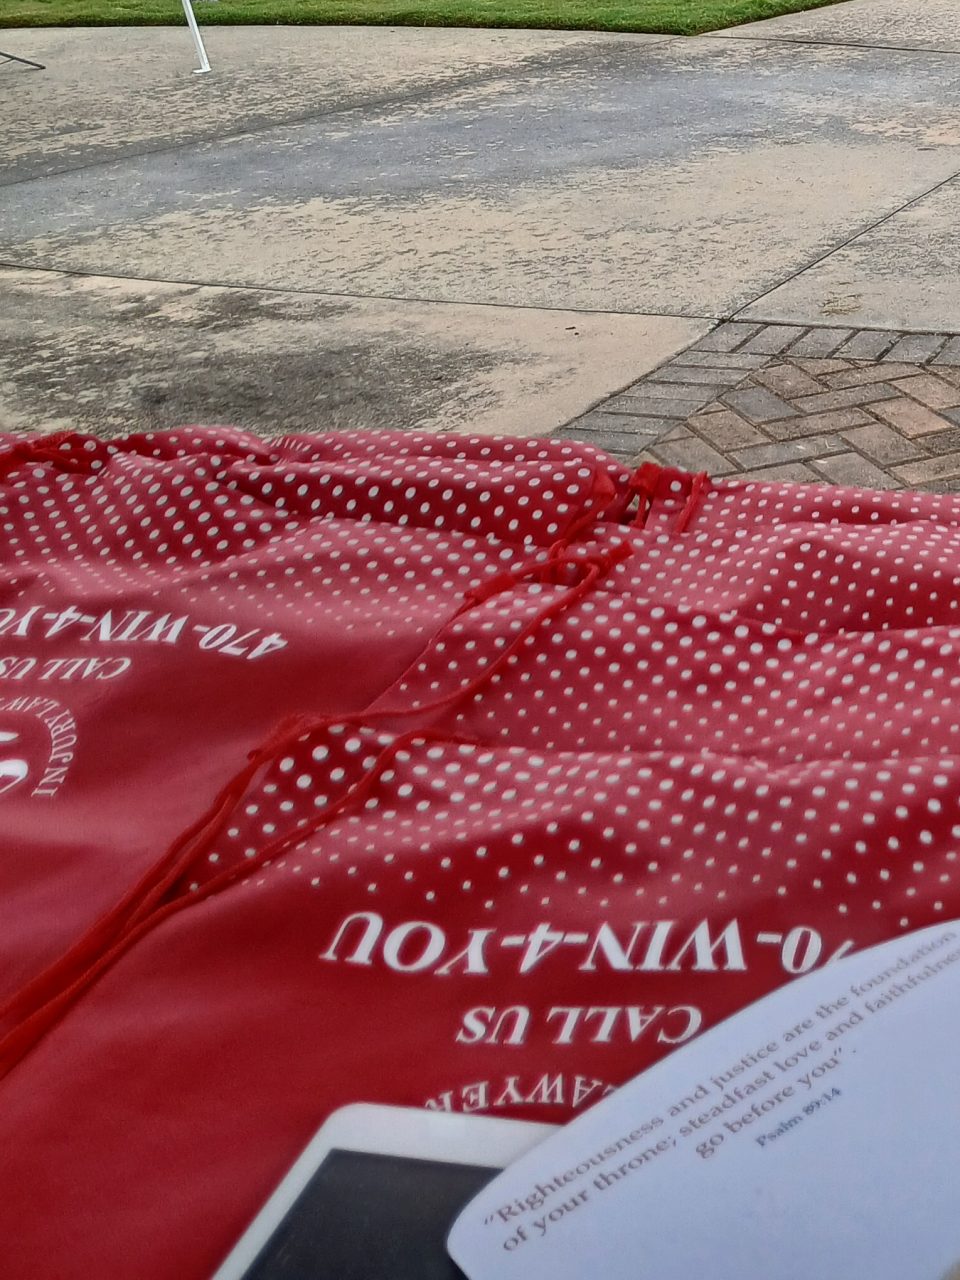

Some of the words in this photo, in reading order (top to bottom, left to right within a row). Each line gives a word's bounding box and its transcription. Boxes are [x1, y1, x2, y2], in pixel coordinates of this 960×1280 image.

[39, 656, 131, 680] CALL
[31, 707, 77, 797] INJURY
[456, 1005, 531, 1046] US
[546, 1005, 703, 1046] CALL
[667, 1084, 708, 1119] and
[710, 1042, 780, 1093] justice
[783, 1018, 815, 1044] are
[815, 994, 850, 1020] the
[851, 930, 958, 999] foundation
[503, 1225, 528, 1252] of
[533, 1189, 590, 1236] your
[593, 1135, 677, 1191] throne;
[679, 1071, 776, 1137] steadfast
[773, 1038, 822, 1073] love
[825, 1012, 864, 1042] and
[695, 1134, 724, 1160] go
[724, 1084, 796, 1134] before
[755, 1114, 805, 1148] Psalm
